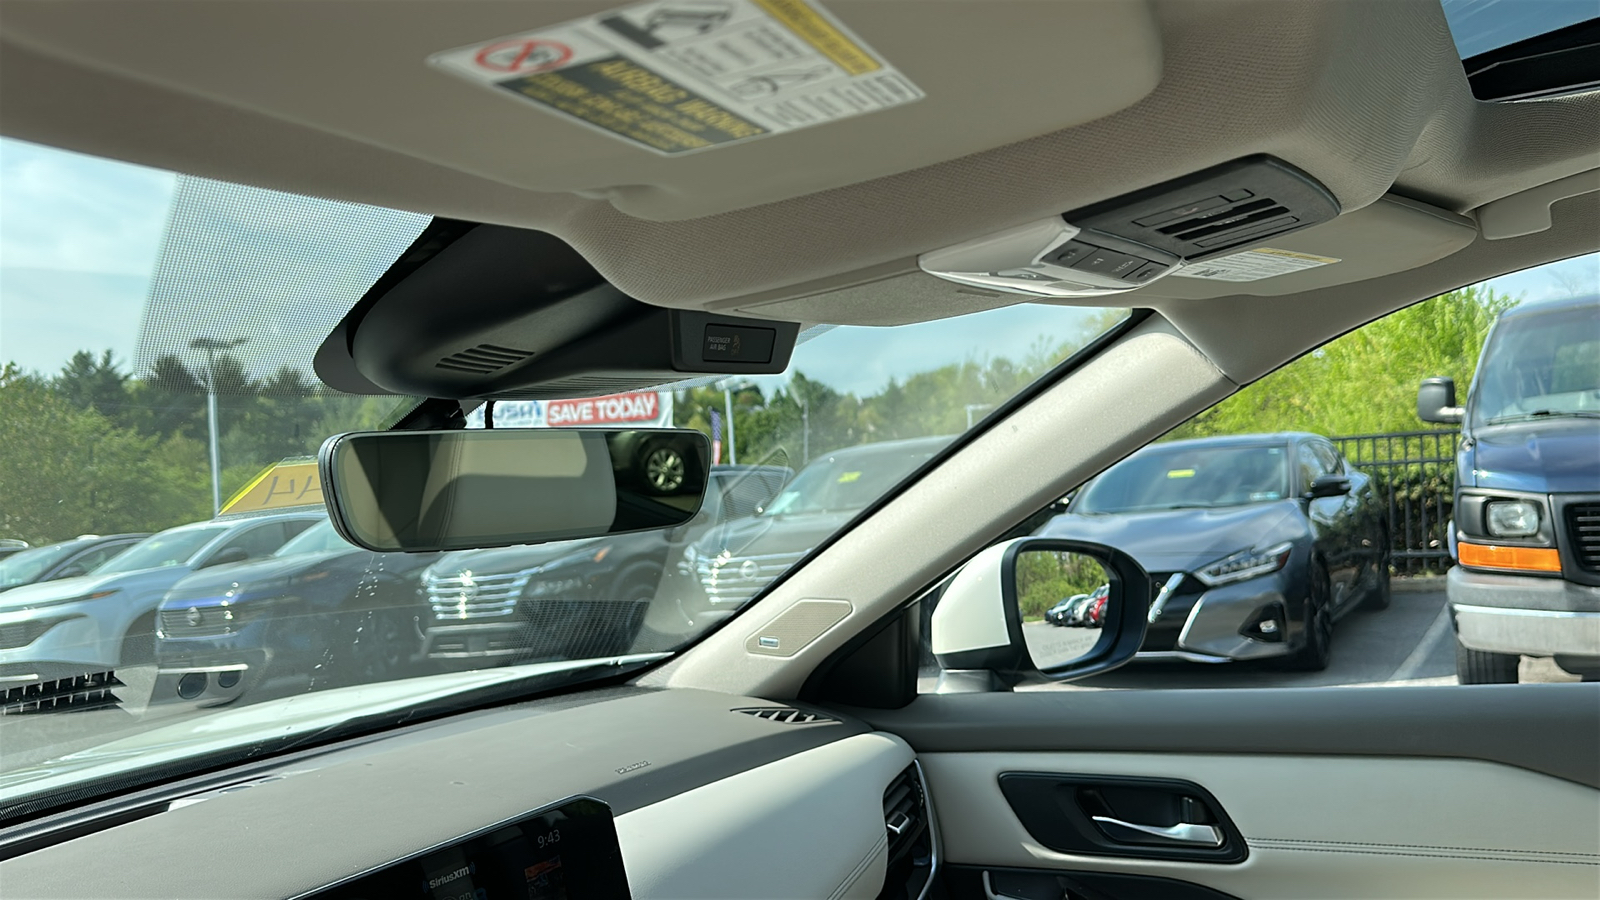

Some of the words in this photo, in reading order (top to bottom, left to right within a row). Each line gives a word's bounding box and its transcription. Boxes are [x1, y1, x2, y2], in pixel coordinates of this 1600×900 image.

[707, 336, 731, 344] PASSENGER
[717, 343, 727, 351] BAG
[549, 401, 592, 422] SAVE
[597, 394, 656, 419] TODAY
[537, 829, 561, 848] 9:43
